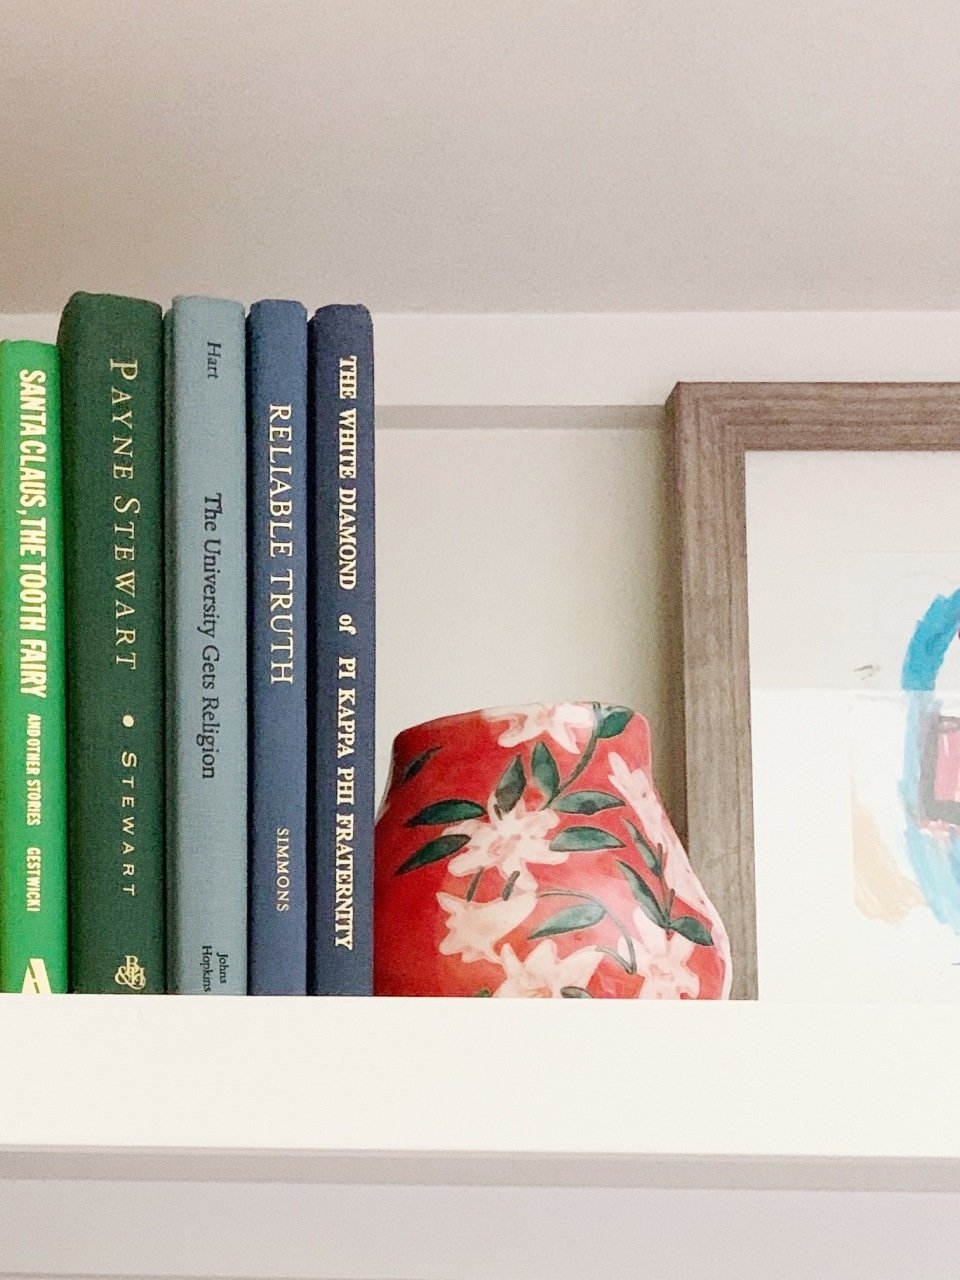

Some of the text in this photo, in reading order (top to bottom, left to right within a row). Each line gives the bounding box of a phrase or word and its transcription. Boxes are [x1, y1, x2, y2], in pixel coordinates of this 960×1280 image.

[207, 342, 221, 378] Hart
[20, 370, 46, 436] SANTA
[20, 518, 46, 557] THE
[110, 359, 140, 669] PAYNE STEWART
[269, 405, 293, 683] RELIABLE TRUTH
[20, 562, 46, 631] TOOTH
[20, 639, 47, 698] FAIRY
[196, 493, 222, 778] The University Gets Religion
[335, 356, 357, 950] THE WHITE DIAMOND of PI KAPPA PHI FRATERNITY
[26, 714, 41, 825] AND OTHER STORIES
[122, 752, 137, 895] STEWART
[27, 847, 41, 911] GESTWICKI
[277, 829, 289, 911] SIMMONS
[200, 945, 214, 992] Hopkins
[217, 953, 229, 983] Johns
